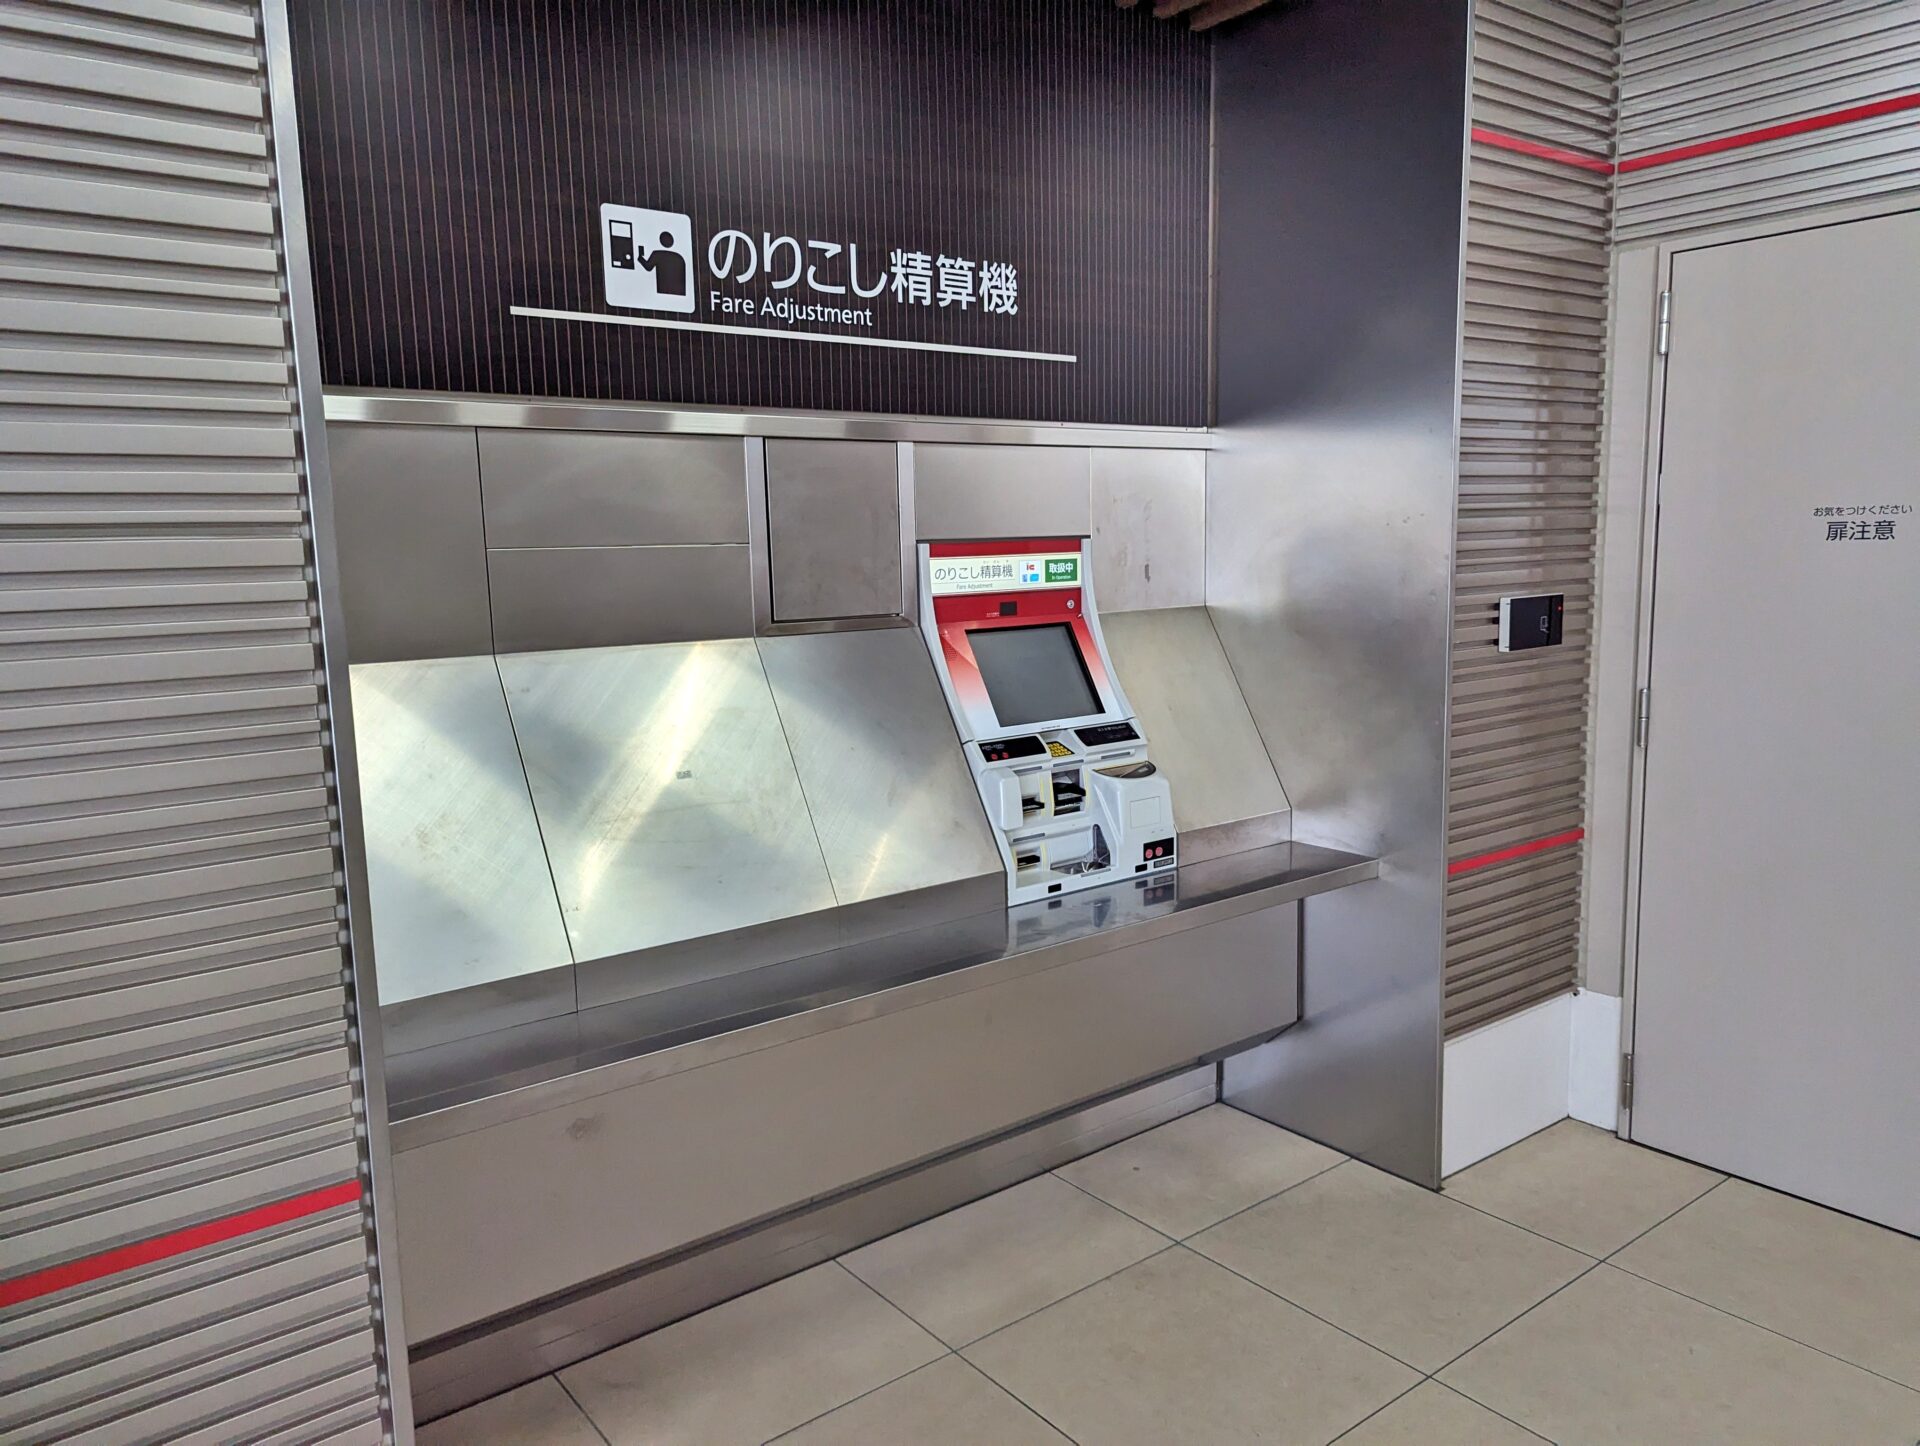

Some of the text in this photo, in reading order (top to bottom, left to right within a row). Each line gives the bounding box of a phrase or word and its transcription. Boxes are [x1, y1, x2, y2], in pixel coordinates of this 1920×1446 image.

[707, 228, 1019, 316] のりこし精算機
[709, 290, 873, 327] Fare Adjustment
[1813, 504, 1912, 517] お気をつけください
[1826, 520, 1896, 541] 扉注意
[934, 564, 1014, 581] のりこし精算機
[1048, 562, 1074, 574] 取扱中
[967, 582, 993, 590] Adjustment
